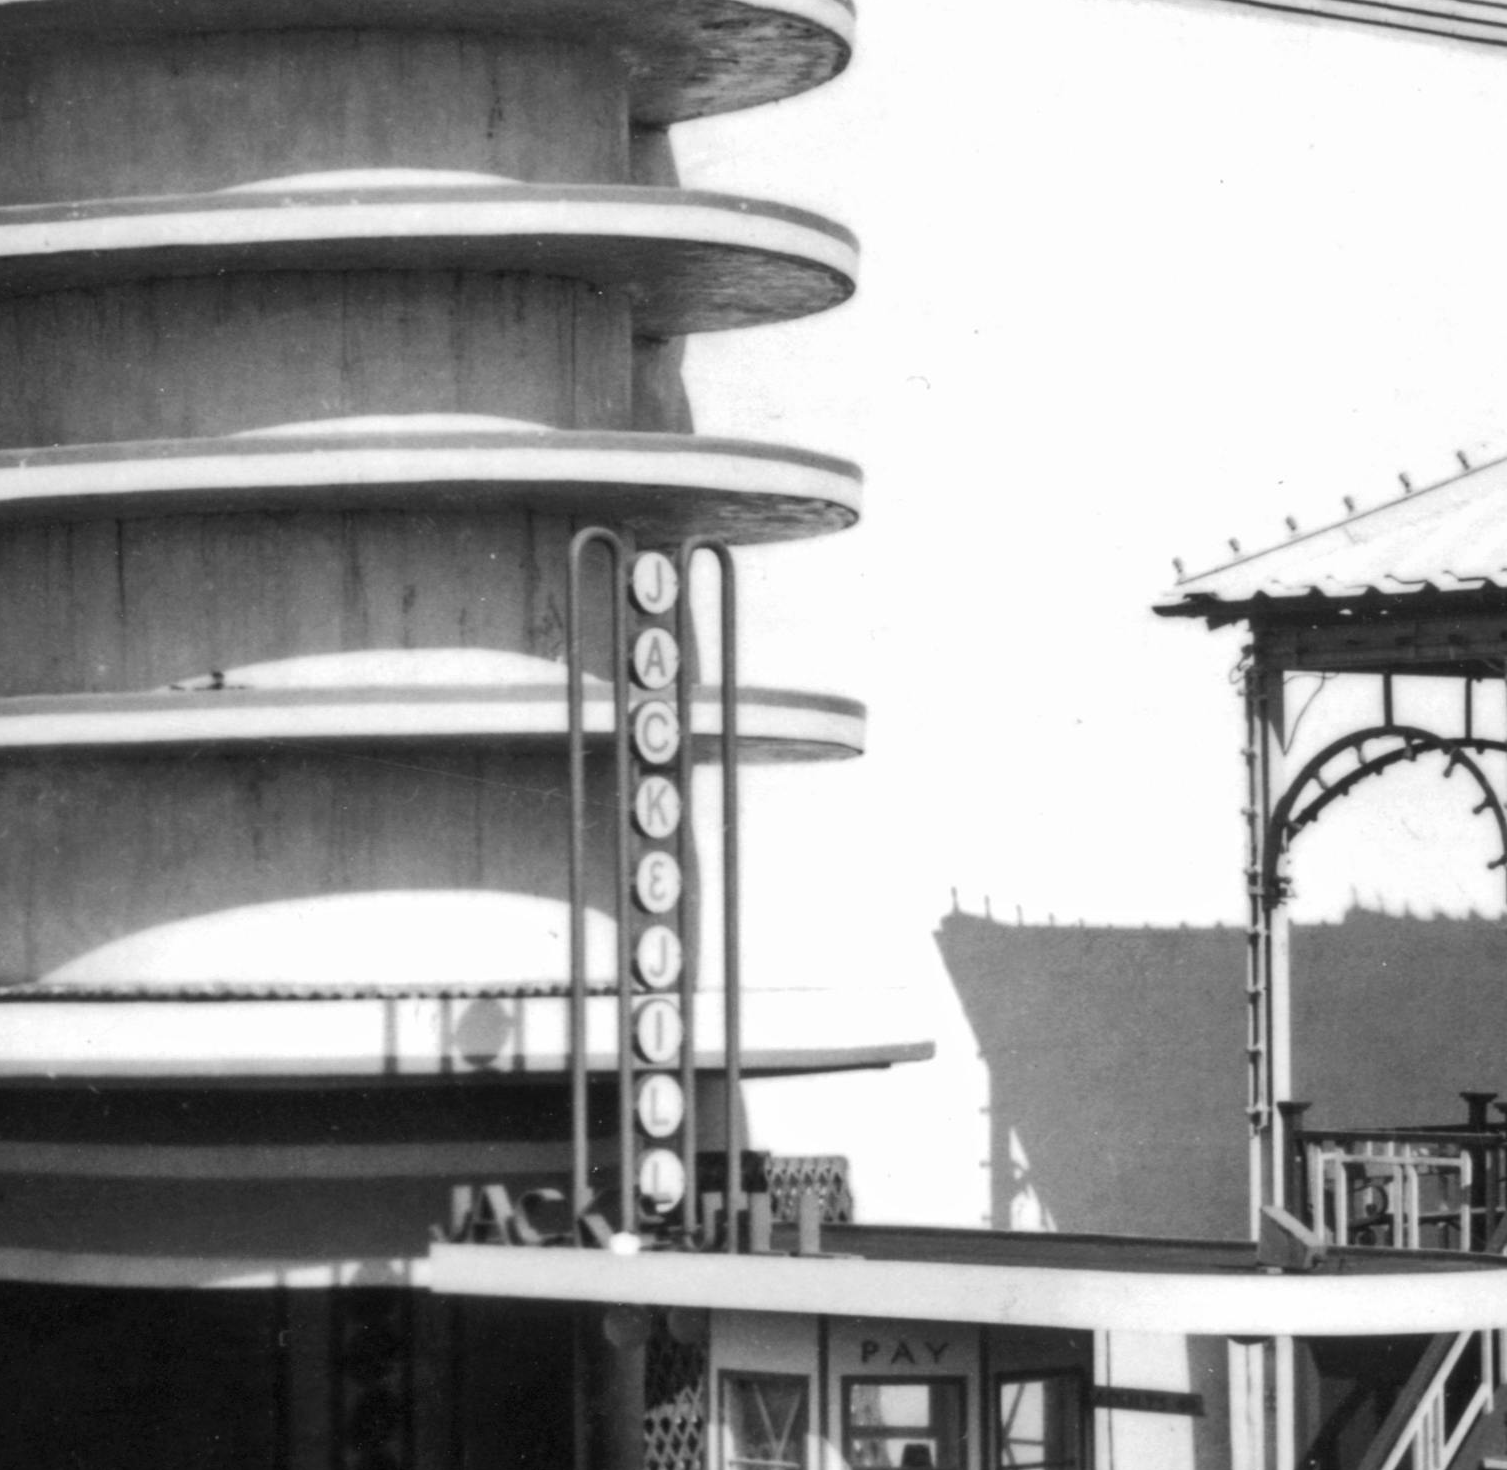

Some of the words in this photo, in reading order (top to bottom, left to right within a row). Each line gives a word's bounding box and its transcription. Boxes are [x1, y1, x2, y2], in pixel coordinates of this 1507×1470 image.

[640, 561, 675, 828] JACK
[645, 936, 681, 1204] JILL
[859, 1339, 950, 1365] PAY
